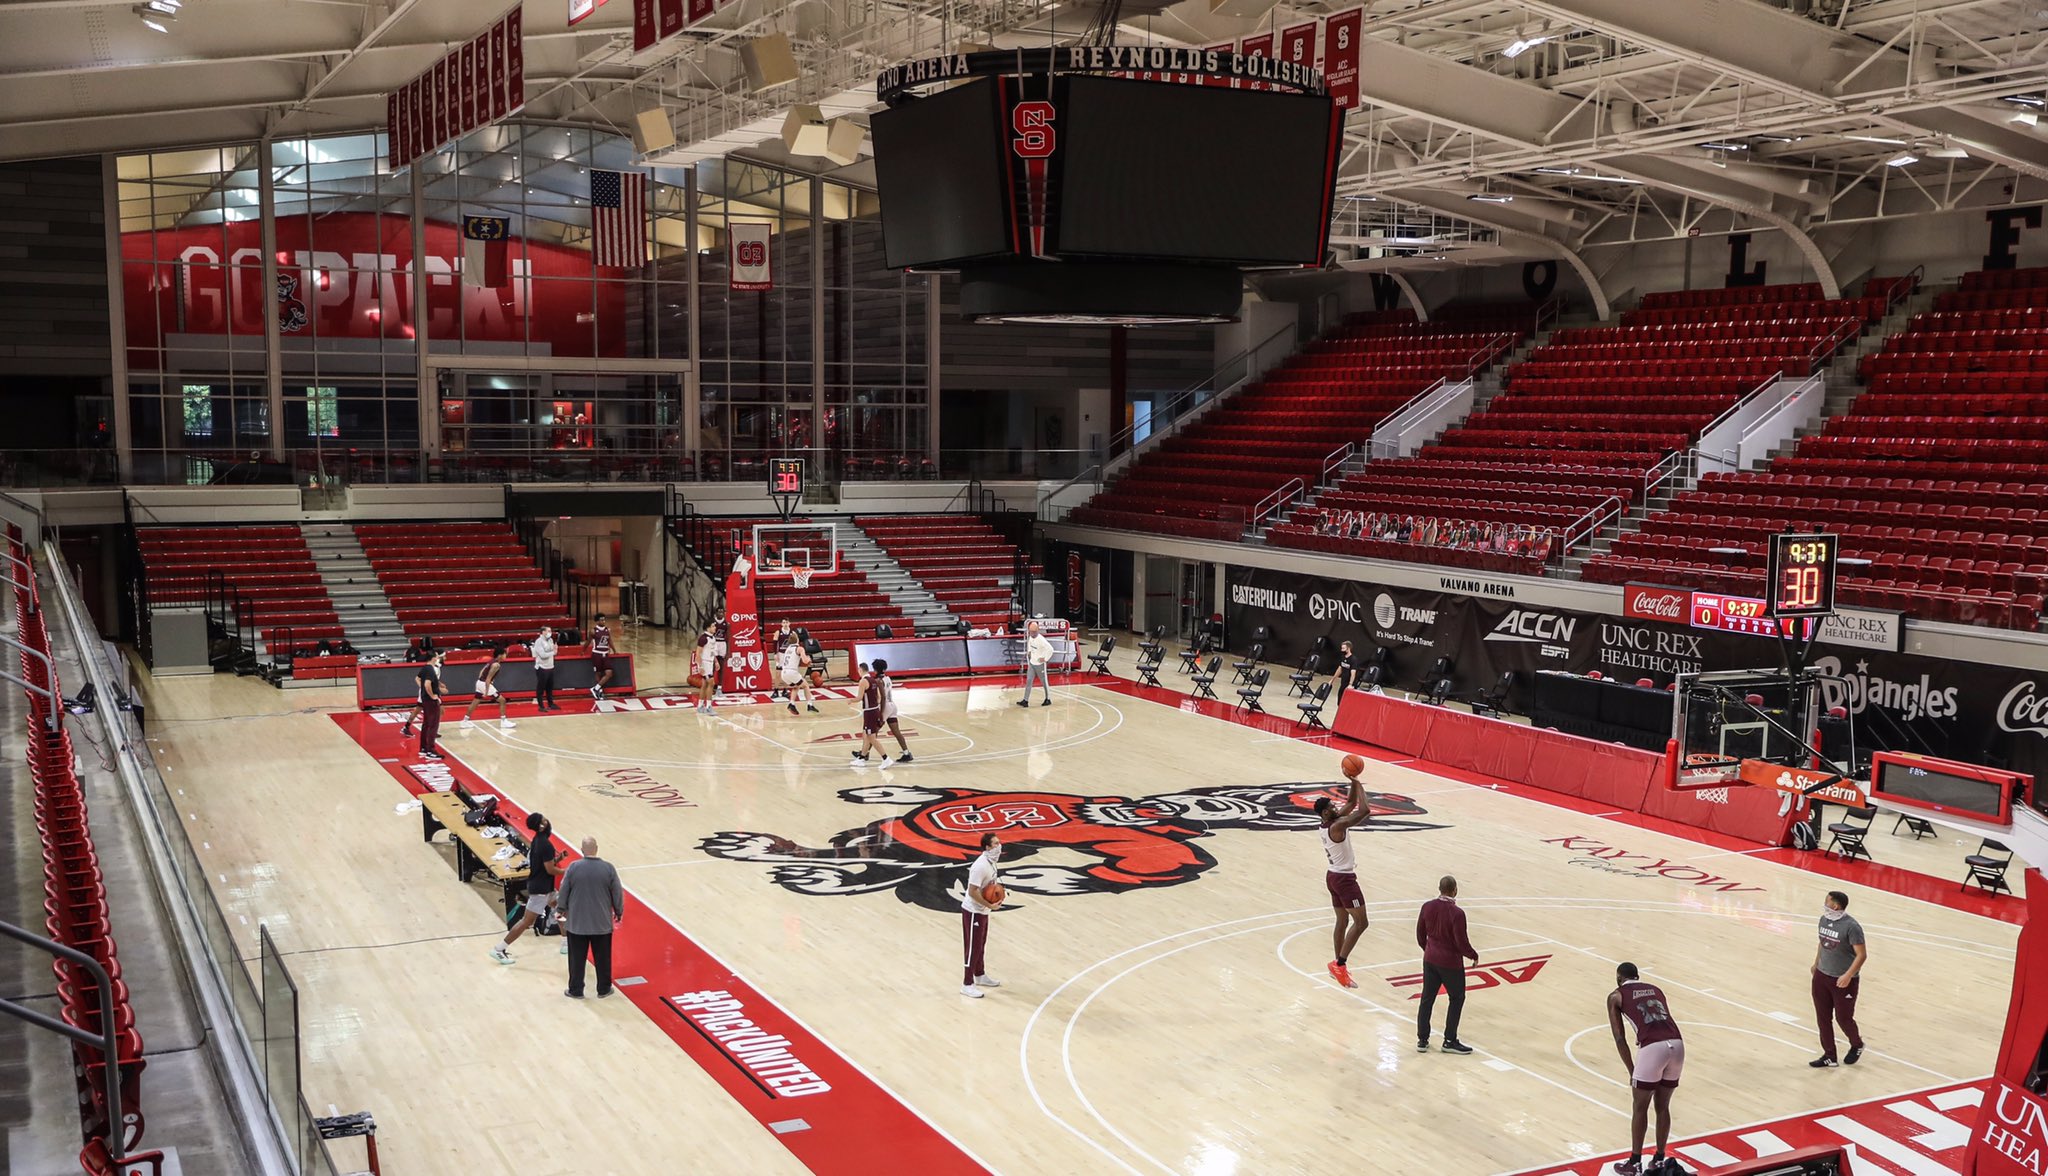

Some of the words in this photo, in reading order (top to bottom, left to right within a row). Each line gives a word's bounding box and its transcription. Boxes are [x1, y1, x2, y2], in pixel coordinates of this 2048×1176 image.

[905, 54, 969, 83] ARENA
[1069, 47, 1218, 72] REYNOLDS
[1232, 53, 1320, 90] COLISEUM
[1725, 233, 1767, 288] L
[1983, 205, 2043, 271] F
[777, 473, 797, 490] 30
[1790, 543, 1826, 564] 9:37
[1232, 584, 1294, 612] CATERPILLAR
[1440, 577, 1480, 592] VALVANO
[1483, 583, 1515, 597] ARENA
[1785, 567, 1819, 606] 30
[1326, 598, 1361, 623] PNC
[1697, 597, 1718, 606] HOME
[1727, 601, 1758, 617] 9:37
[740, 613, 758, 621] PNC
[1400, 606, 1436, 625] TRANE
[1494, 609, 1577, 642] ACCN
[1825, 614, 1855, 629] UNC
[1859, 619, 1888, 632] REX
[1385, 632, 1396, 640] Hard
[1397, 633, 1403, 641] To
[1403, 635, 1414, 645] Stop
[1601, 623, 1650, 650] UNC
[1655, 631, 1703, 658] REX
[1825, 627, 1887, 643] HEALTHCARE
[1541, 644, 1570, 659] ESPN
[1601, 648, 1702, 674] HEALTHCARE
[735, 675, 757, 690] NC
[1996, 681, 2048, 738] Coc
[596, 767, 659, 786] KAY
[628, 784, 699, 808] YOW
[1540, 836, 1650, 860] KAY
[1634, 858, 1767, 892] YOW
[1982, 1121, 2048, 1176] HEA
